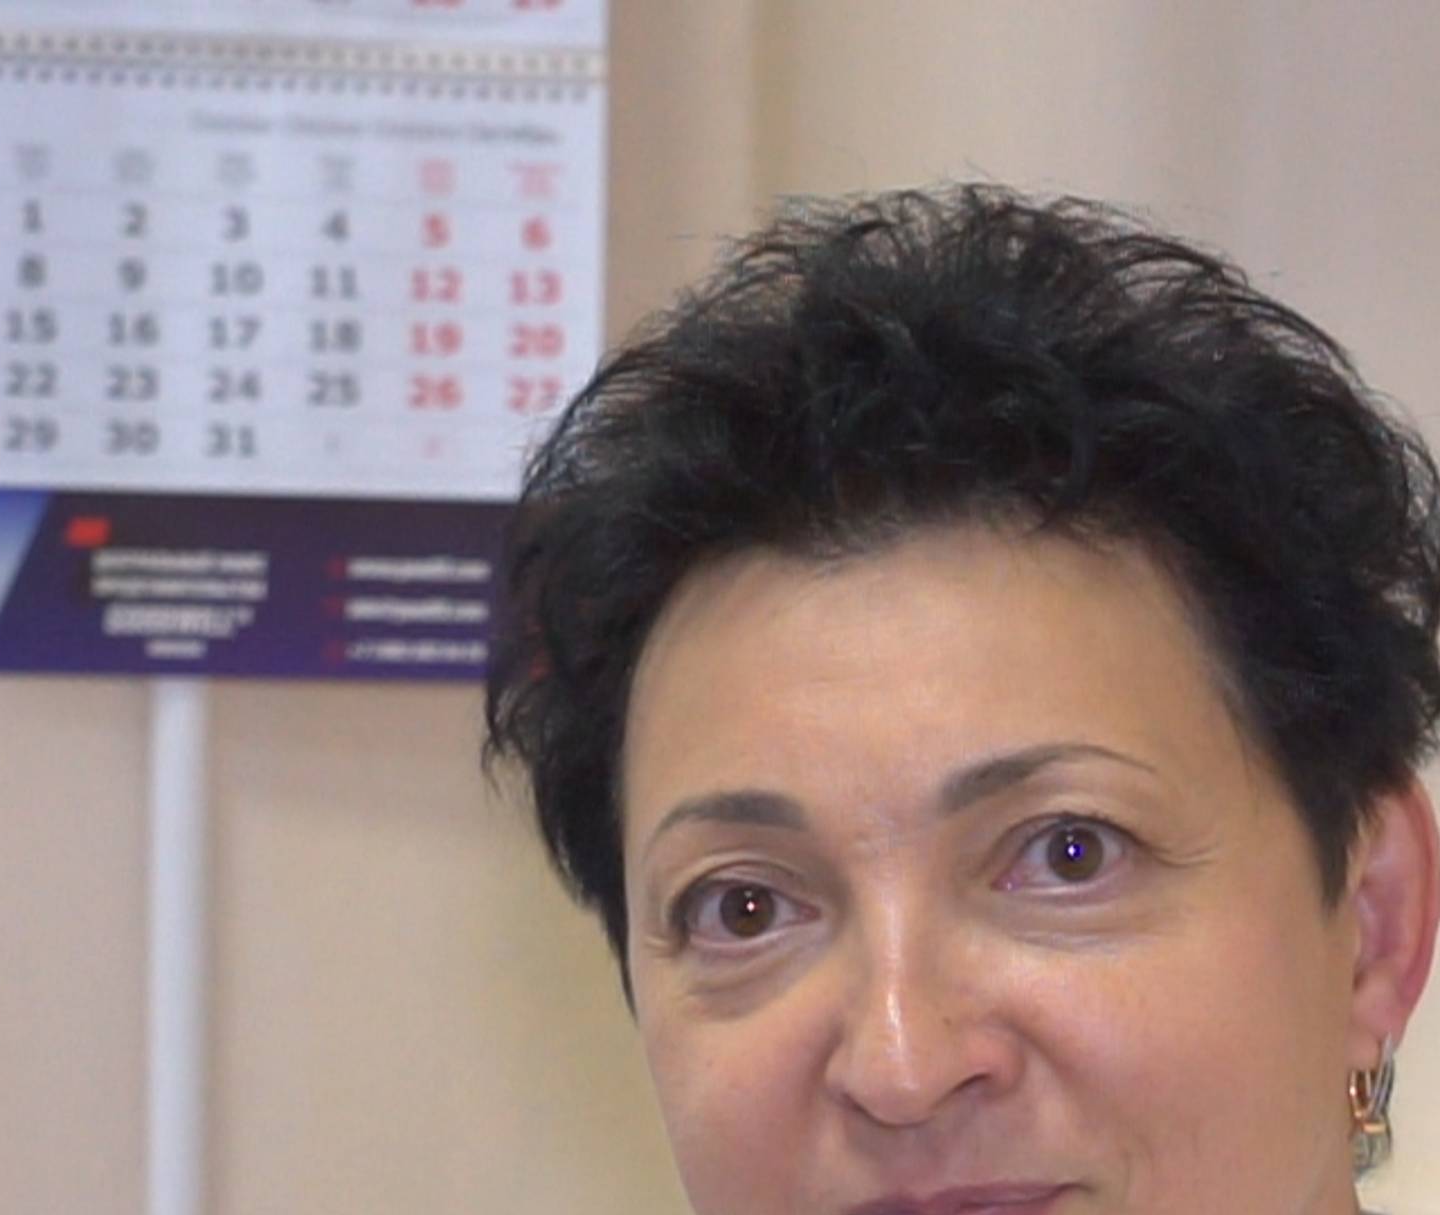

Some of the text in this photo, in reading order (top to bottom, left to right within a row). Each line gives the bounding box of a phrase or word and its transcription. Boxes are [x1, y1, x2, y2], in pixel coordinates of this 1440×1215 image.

[23, 200, 550, 252] 1 2 3 4 5 6
[18, 253, 561, 305] 8 9 10 11 12 13
[6, 309, 563, 358] 15 16 17 18 19 20
[5, 363, 57, 397] 22
[107, 367, 158, 401] 23
[208, 369, 261, 404] 24
[308, 372, 360, 407] 25
[408, 376, 462, 410] 26
[5, 418, 257, 459] 29 30 31
